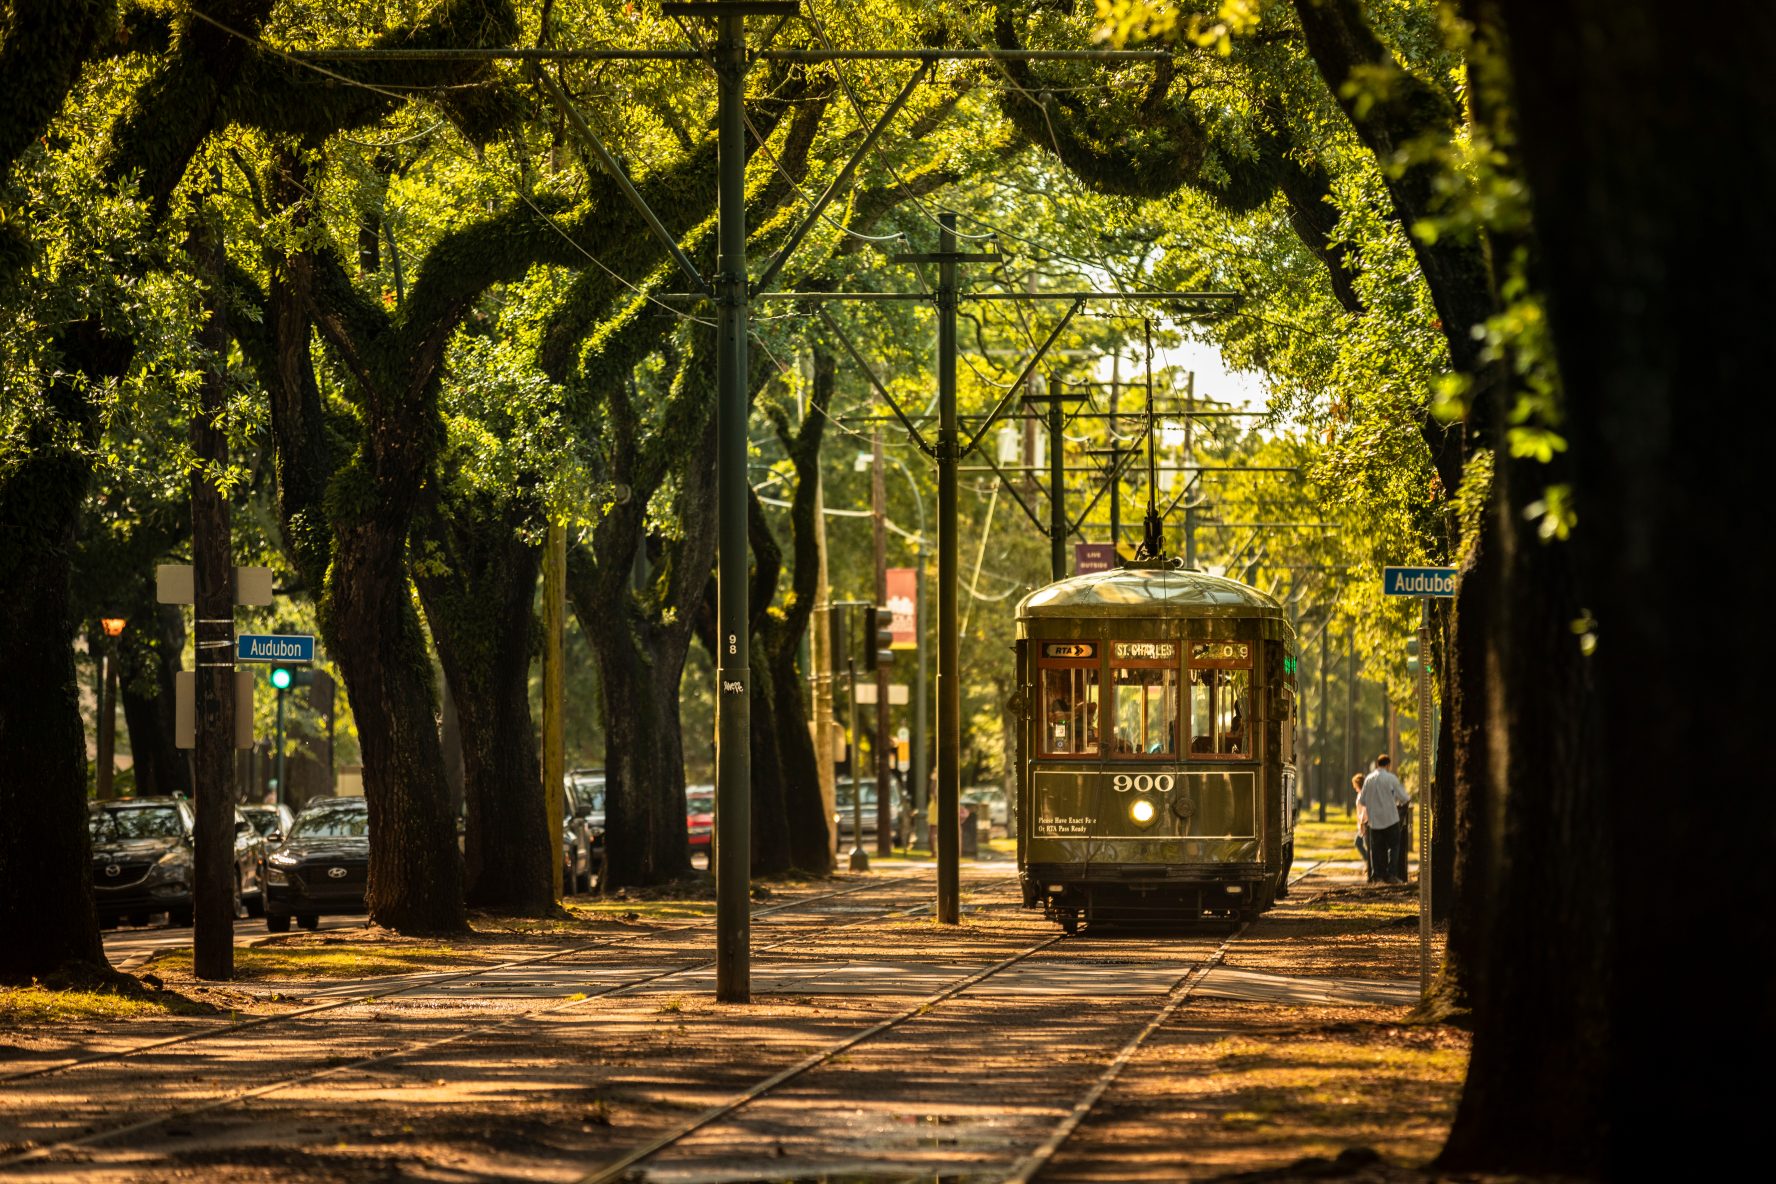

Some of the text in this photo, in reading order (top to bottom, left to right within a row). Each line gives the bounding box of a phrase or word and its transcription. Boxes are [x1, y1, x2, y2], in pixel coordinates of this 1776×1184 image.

[1395, 572, 1454, 592] Audubo
[250, 639, 301, 656] Audubon
[1055, 647, 1072, 655] RTA
[1131, 644, 1172, 657] CHARLES
[1113, 775, 1174, 792] 900
